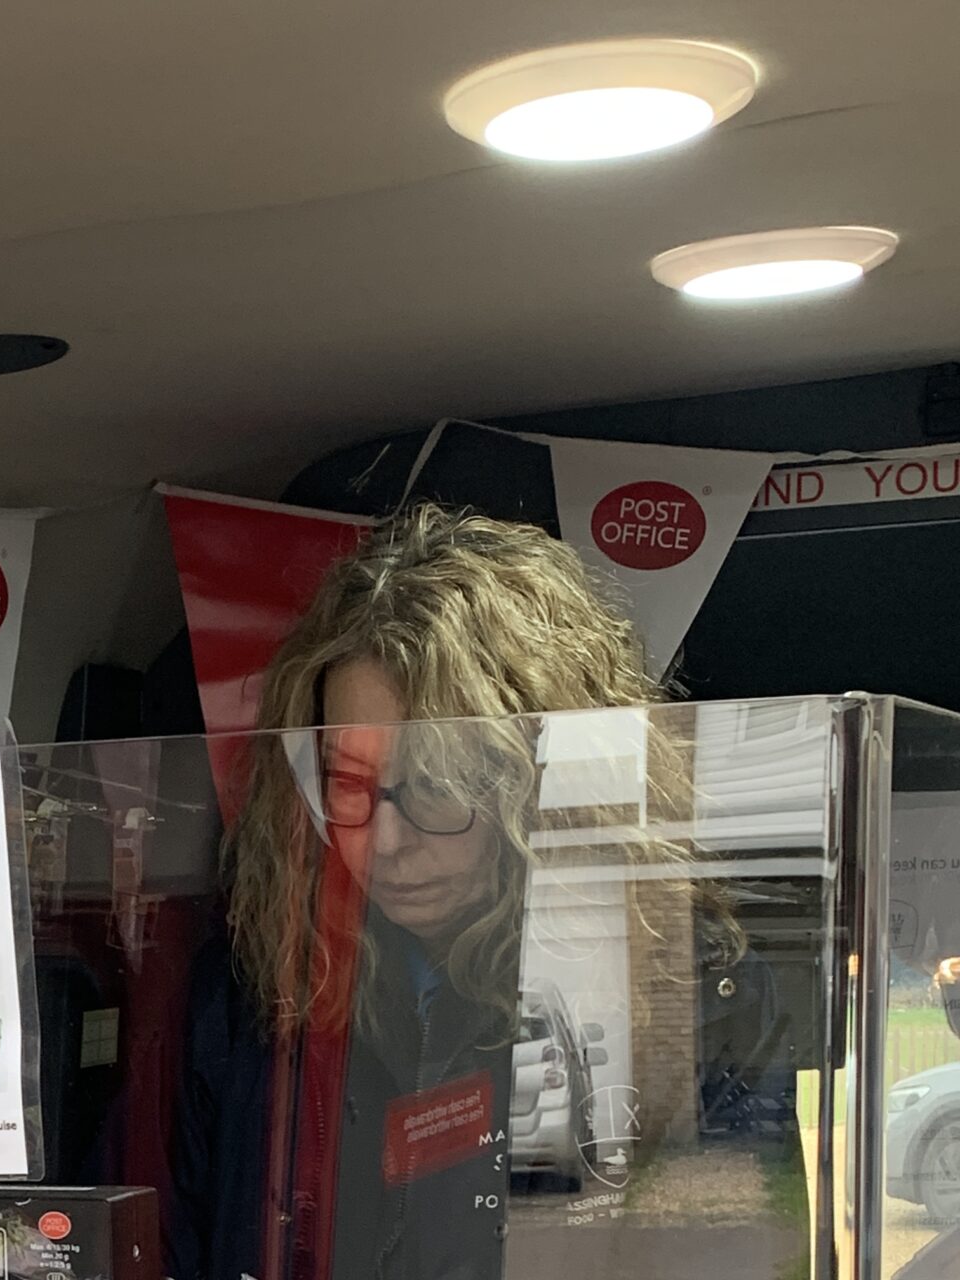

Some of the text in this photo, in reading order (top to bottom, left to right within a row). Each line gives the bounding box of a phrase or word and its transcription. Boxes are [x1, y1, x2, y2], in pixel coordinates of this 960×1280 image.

[753, 471, 825, 507] ND
[620, 497, 686, 524] POST
[601, 521, 691, 551] OFFICE
